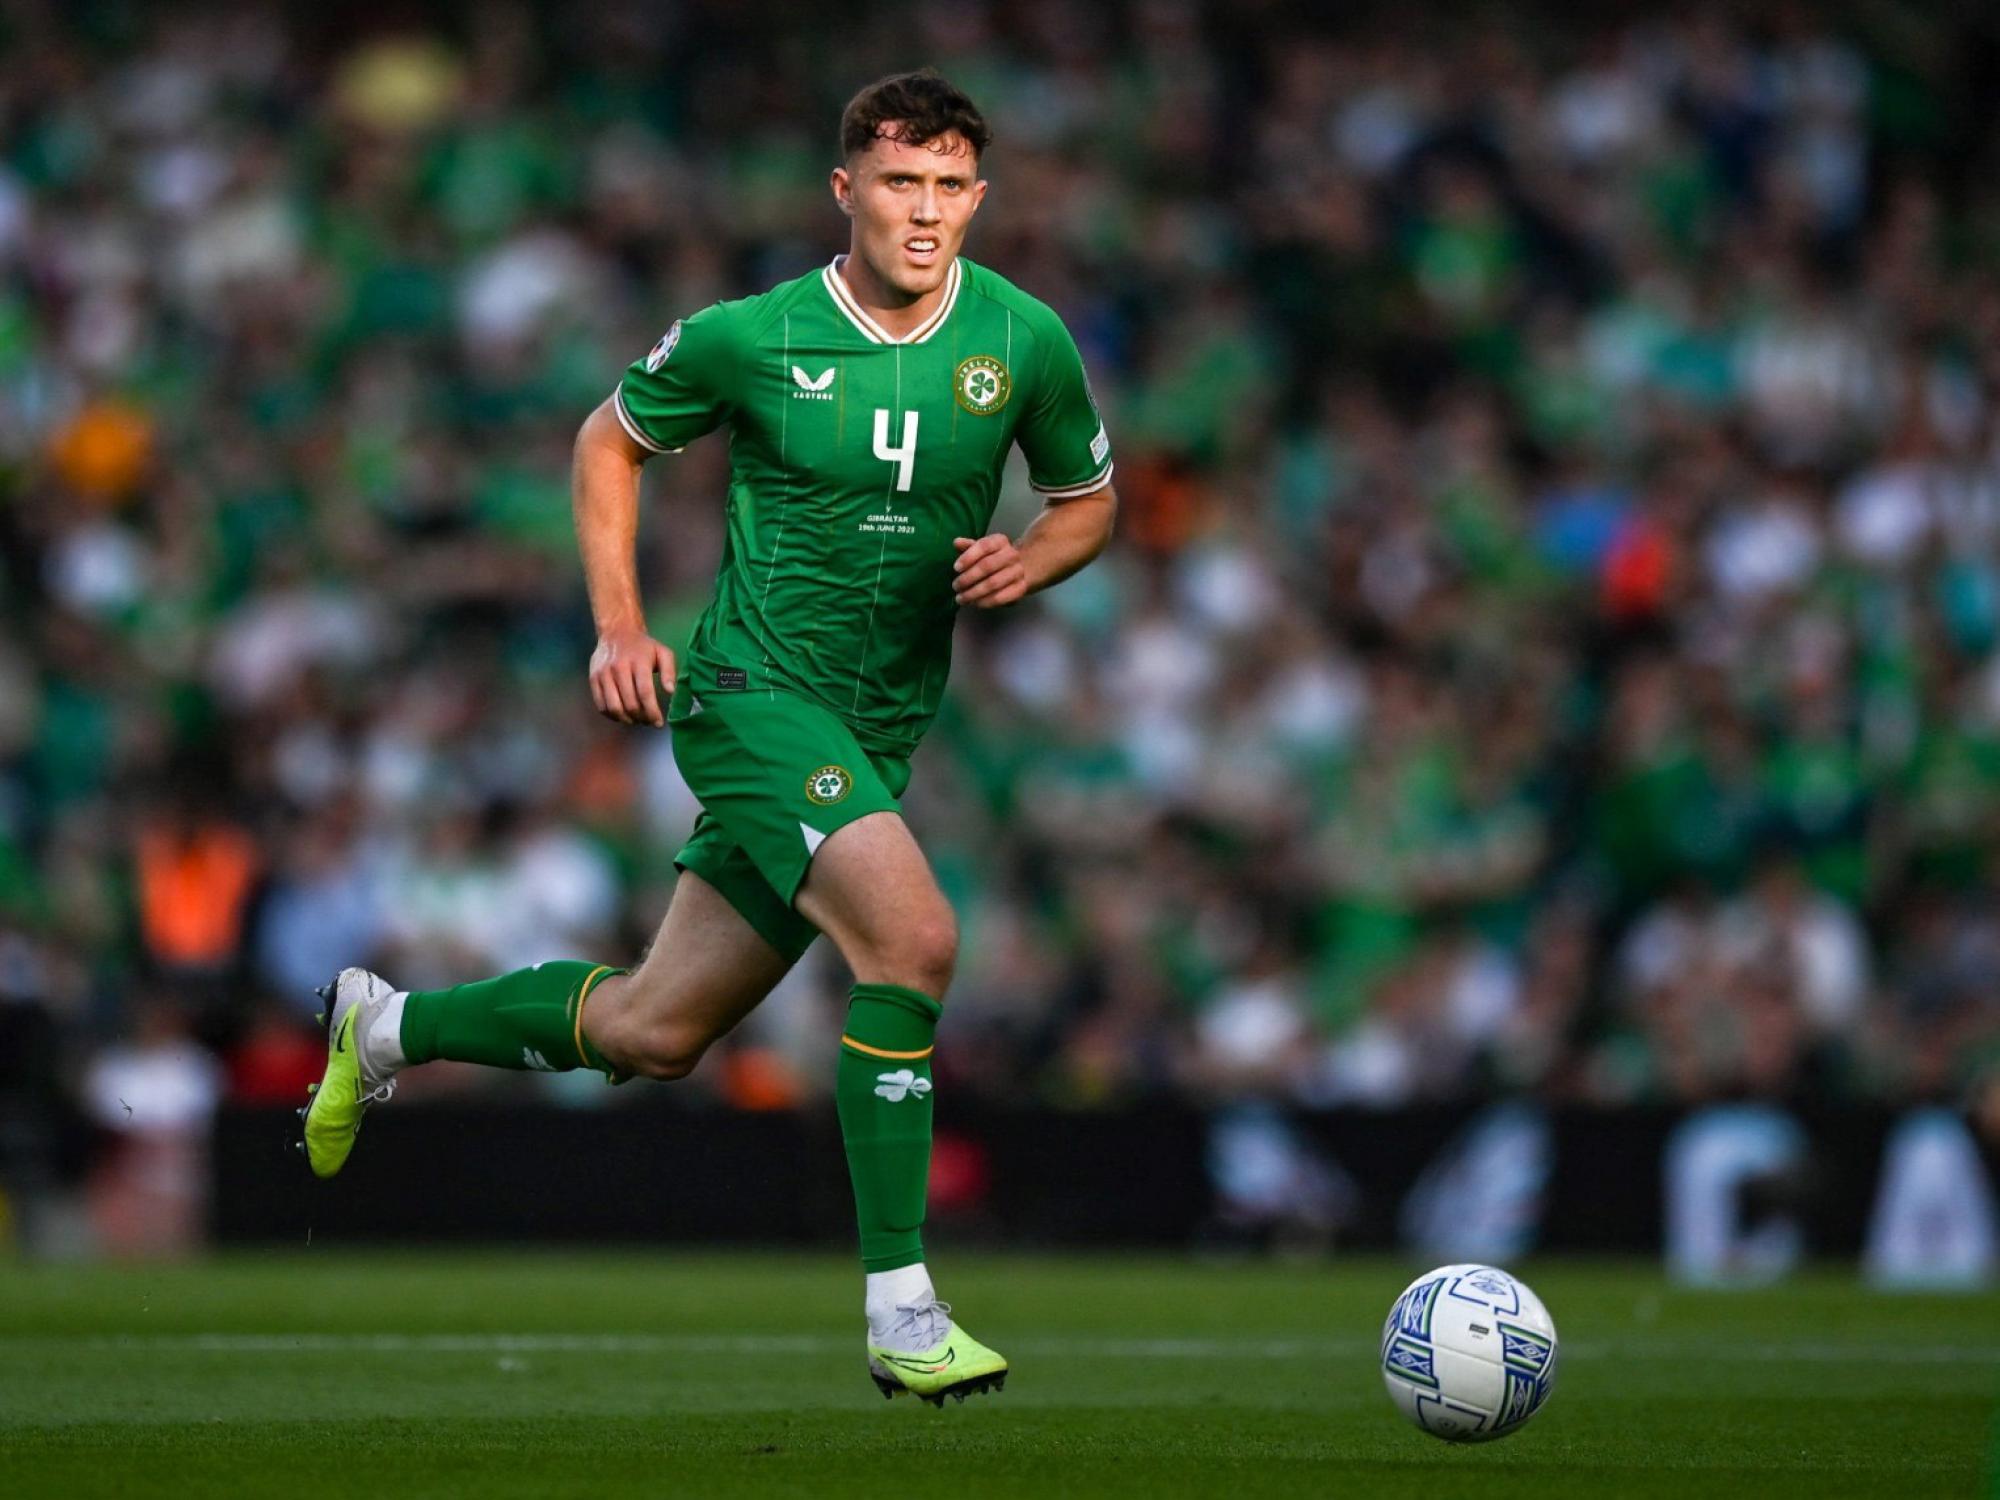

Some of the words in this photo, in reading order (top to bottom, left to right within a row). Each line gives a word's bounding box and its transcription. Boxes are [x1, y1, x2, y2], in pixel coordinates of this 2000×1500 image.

[872, 408, 919, 492] 4
[866, 514, 909, 523] GIBRALTAR
[858, 523, 875, 532] 19th
[876, 524, 895, 533] JUNE
